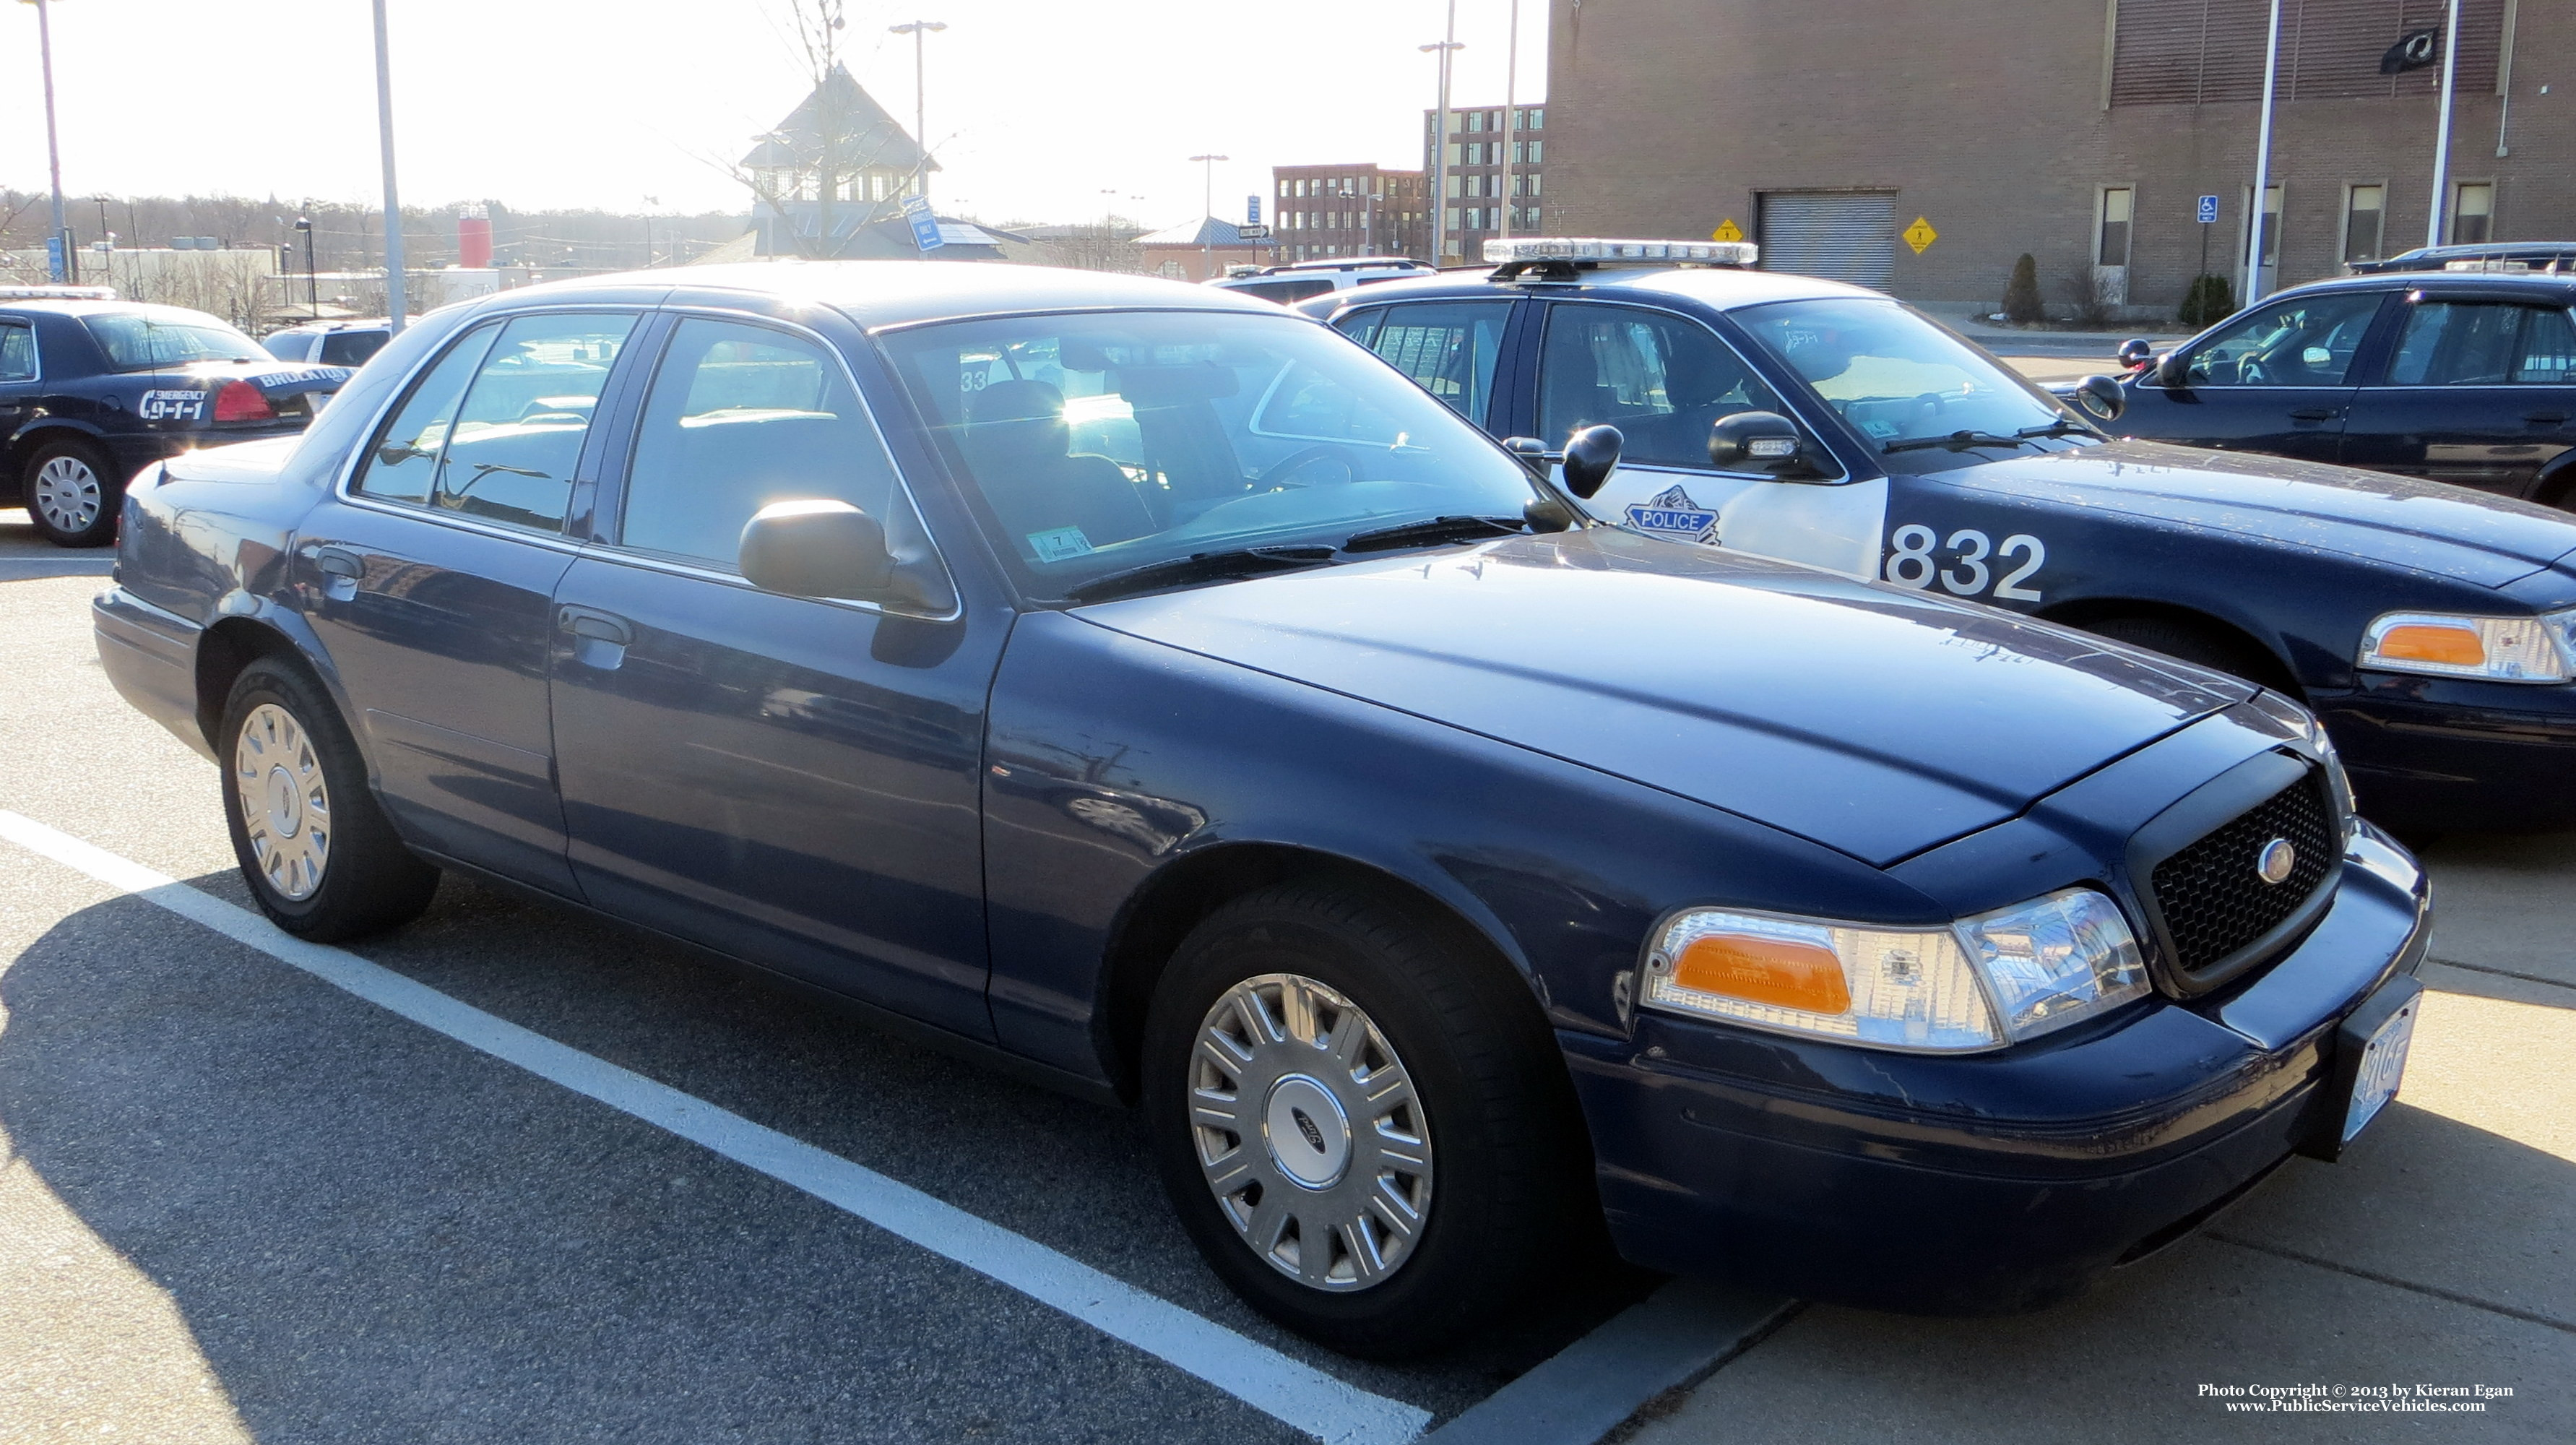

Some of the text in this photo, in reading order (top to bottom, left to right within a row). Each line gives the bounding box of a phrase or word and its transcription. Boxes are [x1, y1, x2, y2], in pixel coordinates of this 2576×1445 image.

[961, 371, 987, 392] 33
[150, 401, 204, 420] 9-1-1
[1641, 512, 1700, 530] POLICE
[1886, 524, 2045, 603] 832
